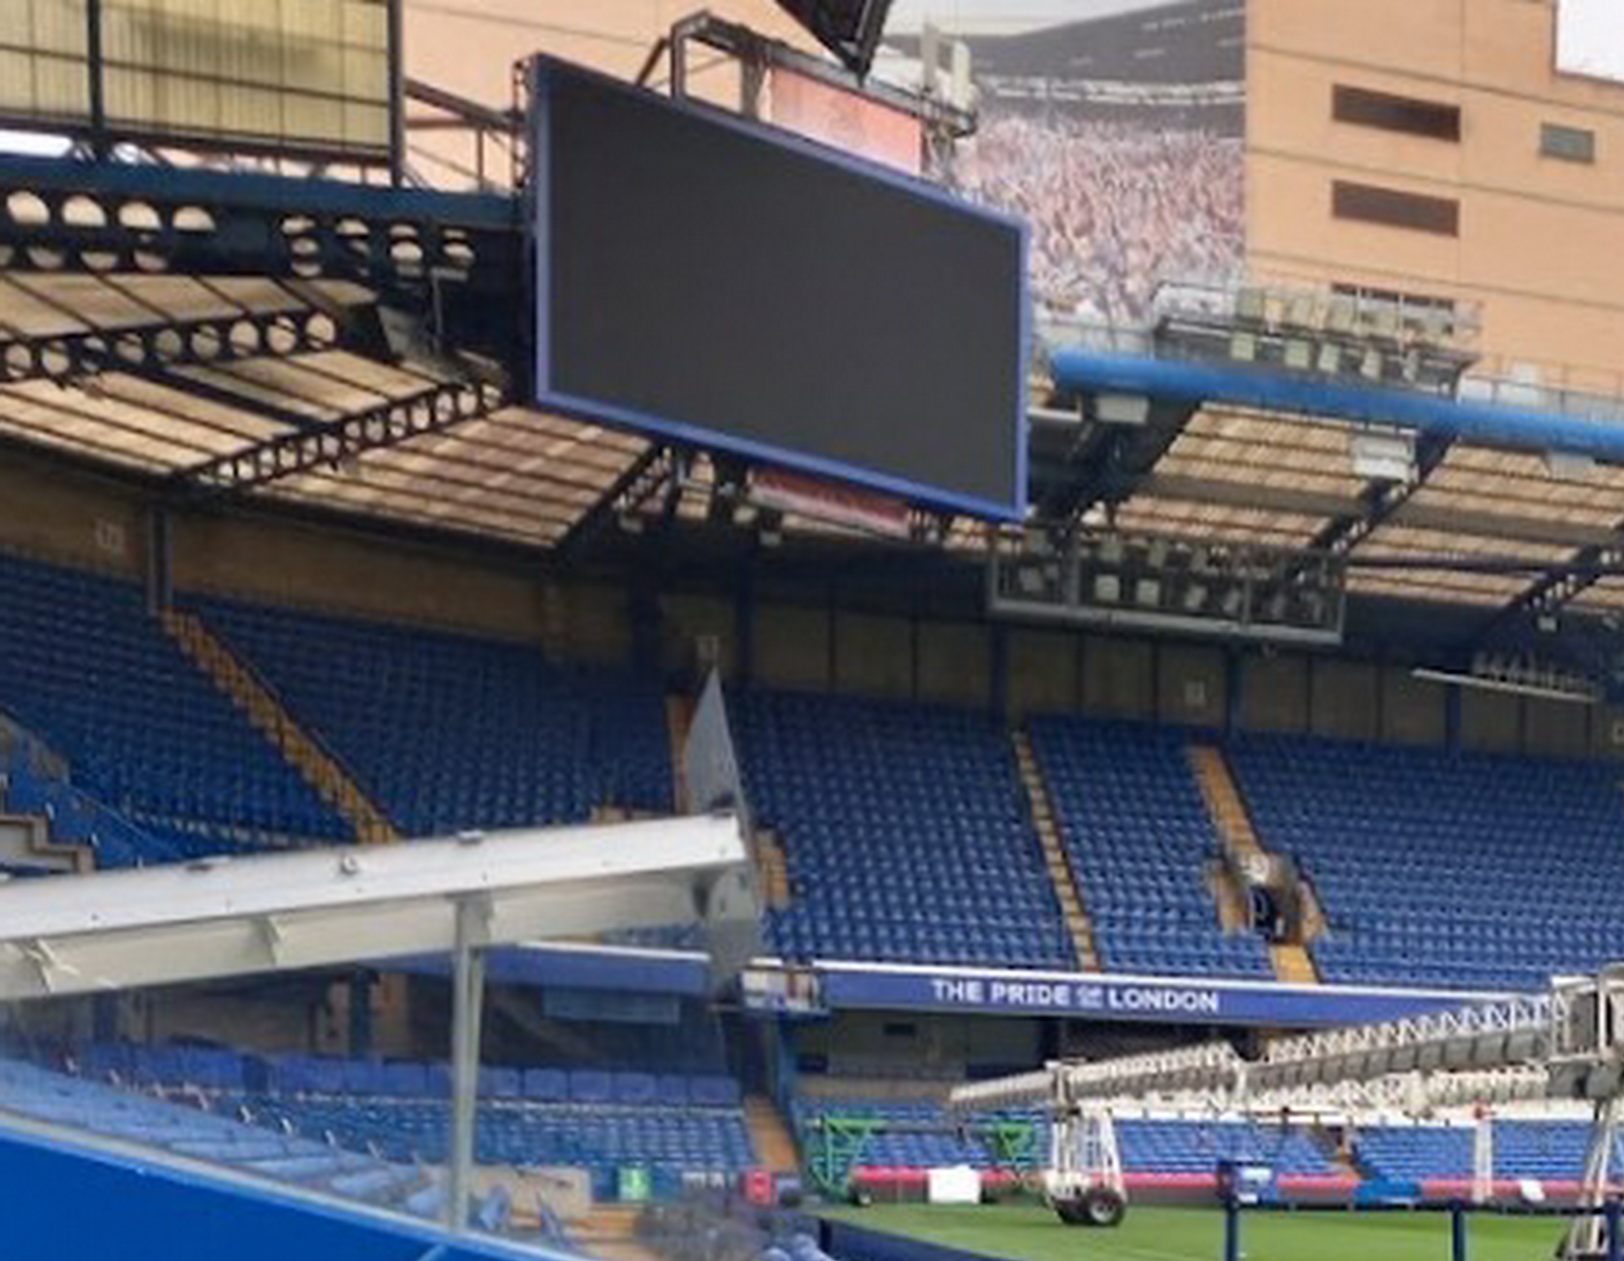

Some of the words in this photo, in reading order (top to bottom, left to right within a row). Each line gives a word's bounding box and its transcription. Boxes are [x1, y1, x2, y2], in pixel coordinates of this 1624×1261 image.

[931, 979, 983, 1002] THE
[990, 982, 1070, 1006] PRIDE
[1108, 988, 1219, 1013] LONDON
